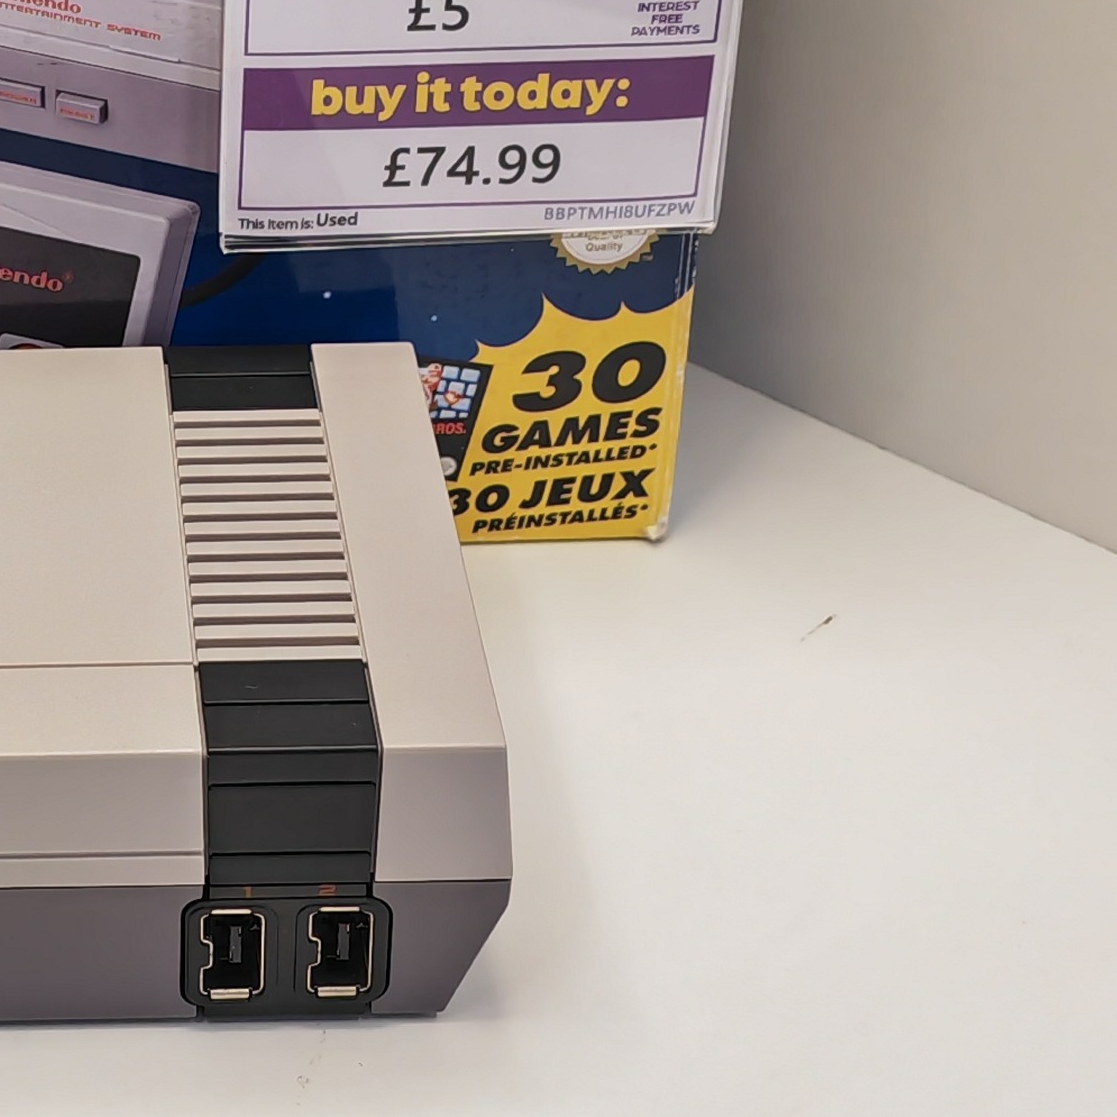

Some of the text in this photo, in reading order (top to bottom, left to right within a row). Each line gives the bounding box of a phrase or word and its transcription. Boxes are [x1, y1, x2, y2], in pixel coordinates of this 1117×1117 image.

[637, 0, 700, 12] INTEREST
[651, 14, 683, 24] FREE
[107, 24, 161, 41] SYSTEM
[631, 24, 700, 36] PAYMENTS
[310, 71, 631, 122] buy it today:
[382, 143, 562, 188] £74.99
[238, 218, 265, 229] This
[315, 211, 359, 227] Used
[585, 242, 623, 252] Quality
[512, 341, 666, 413] 30
[433, 422, 466, 434] ROS.
[481, 407, 663, 454] GAMES
[448, 468, 656, 516] 30 JEUX
